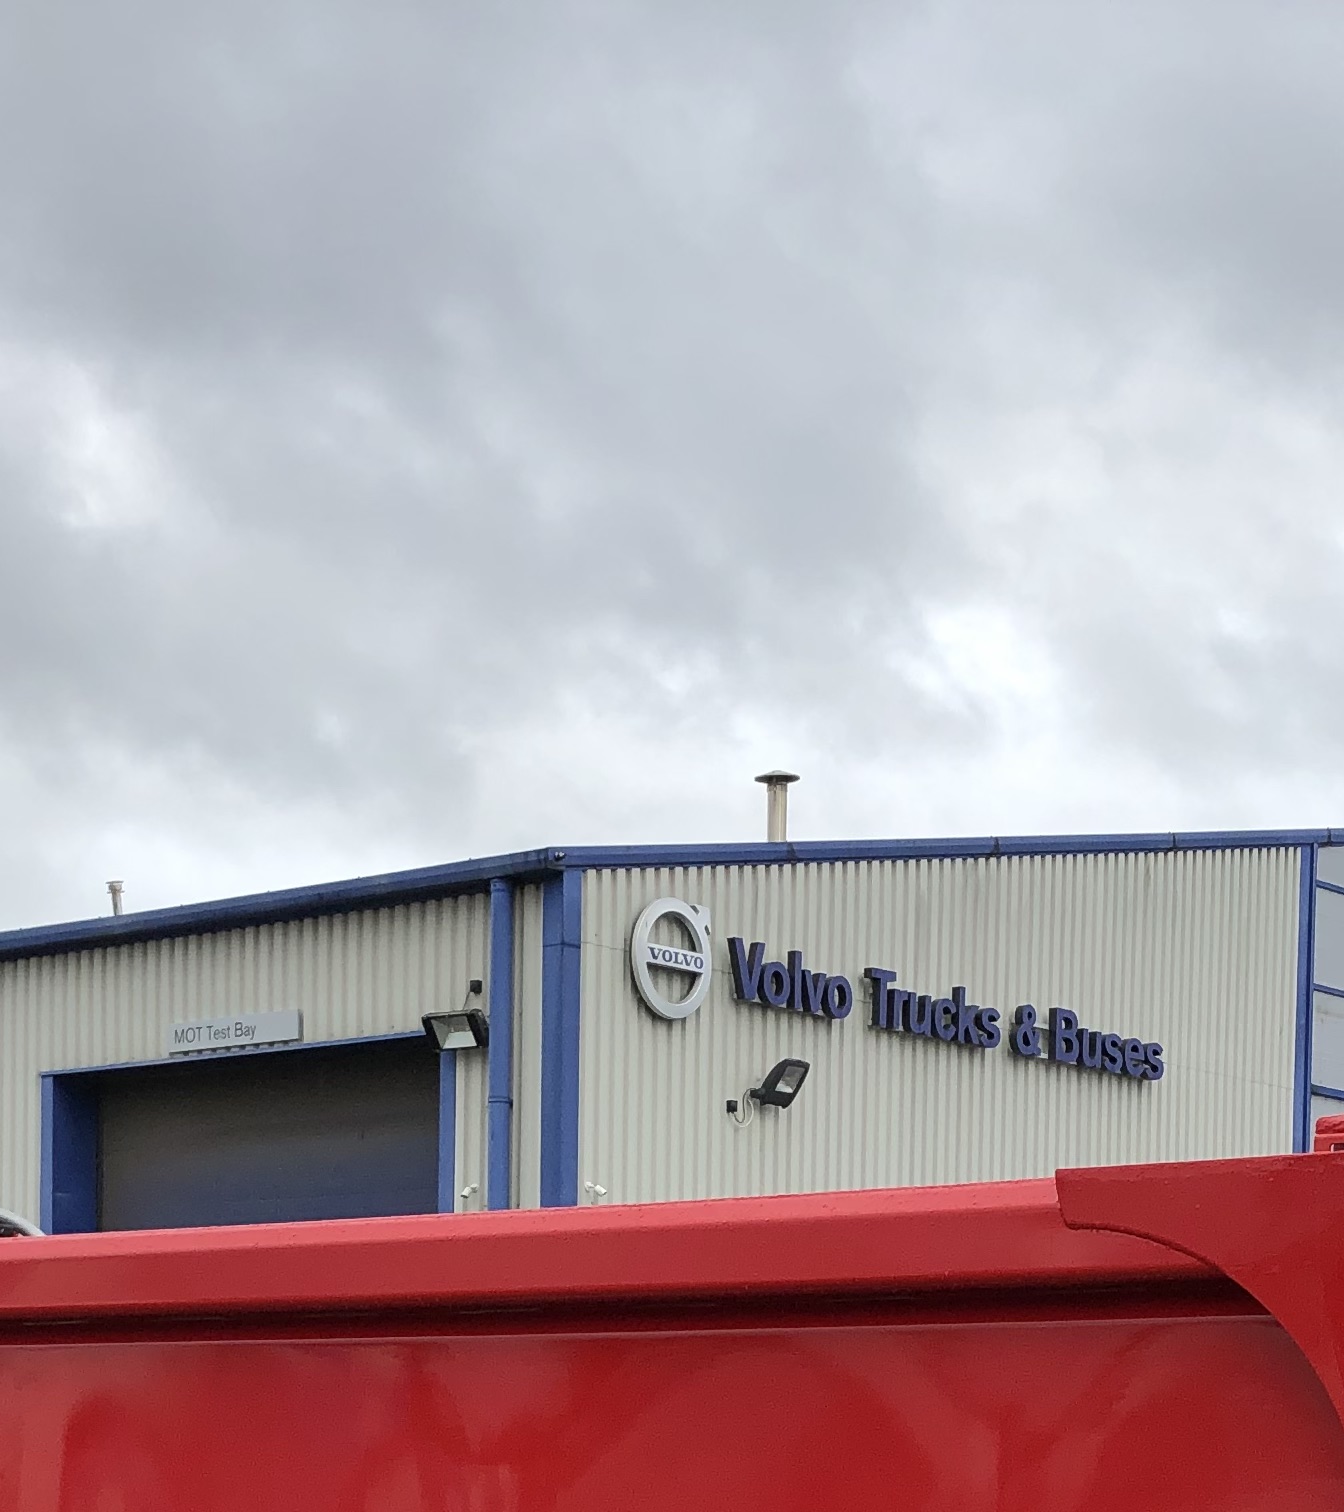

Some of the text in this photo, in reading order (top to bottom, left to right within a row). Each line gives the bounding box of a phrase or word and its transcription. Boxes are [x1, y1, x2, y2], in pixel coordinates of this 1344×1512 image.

[647, 946, 704, 970] VOLVO
[727, 936, 1164, 1081] Volvo Trucks & Buses
[173, 1021, 257, 1044] MOT Test Bay
